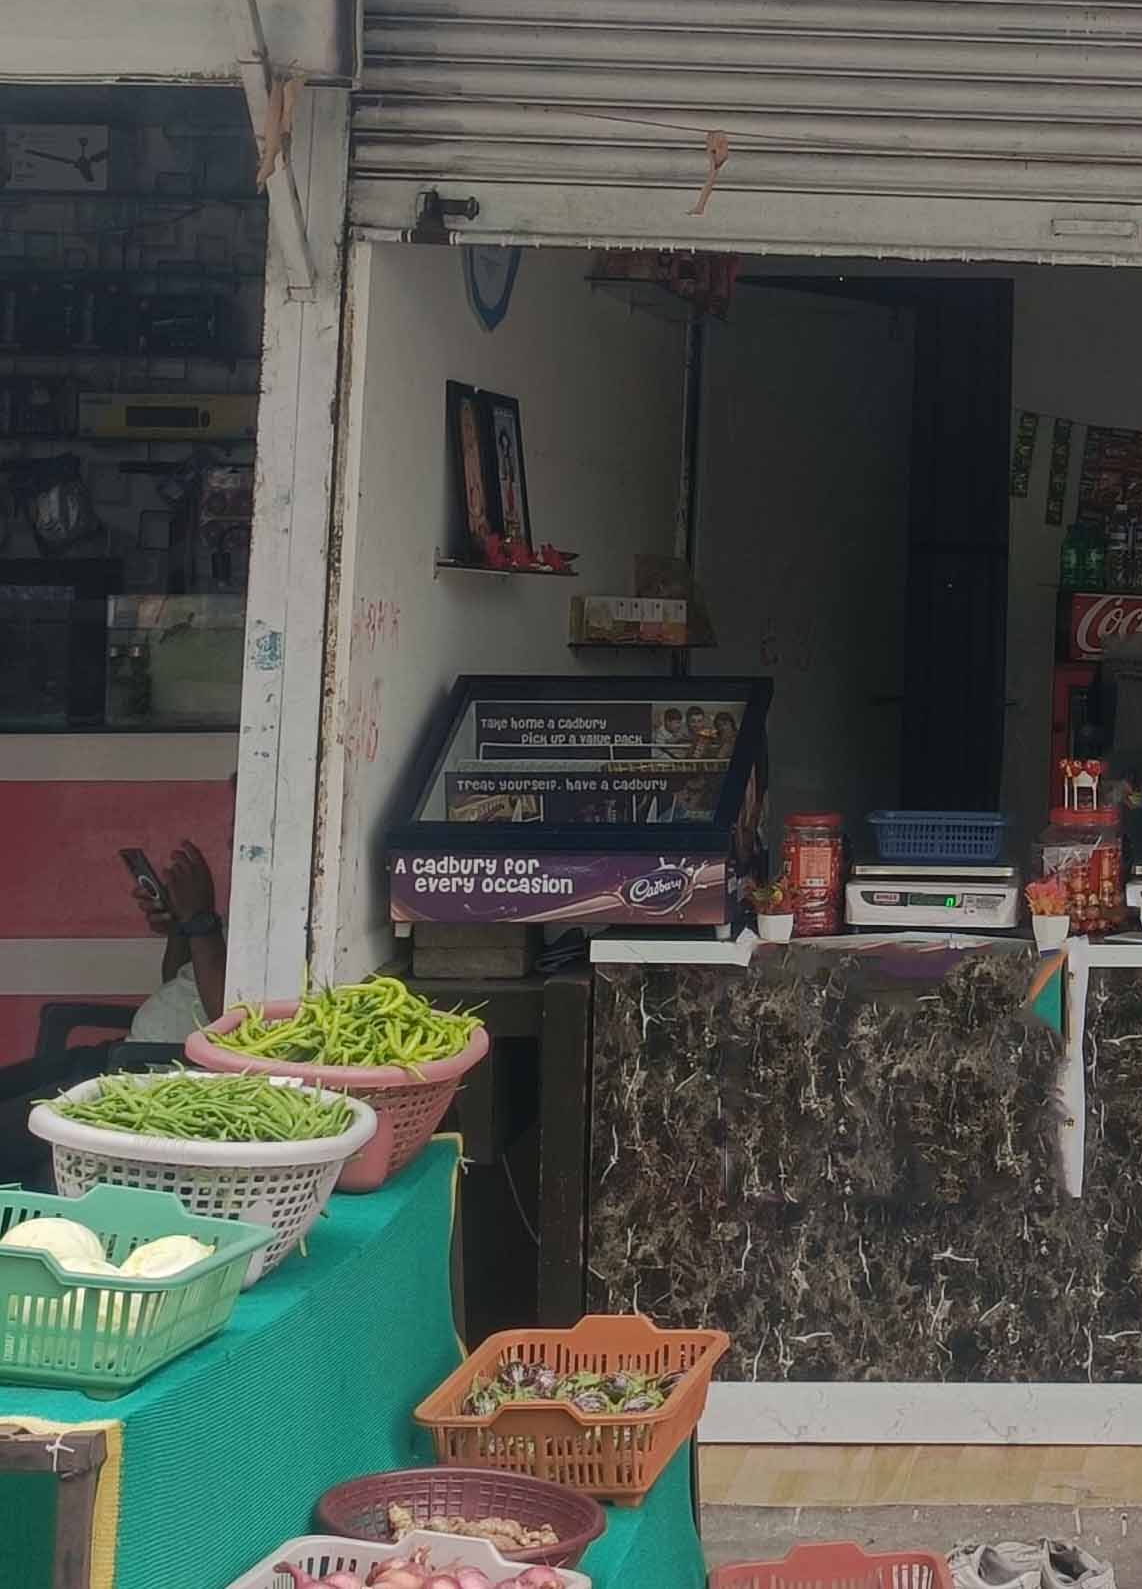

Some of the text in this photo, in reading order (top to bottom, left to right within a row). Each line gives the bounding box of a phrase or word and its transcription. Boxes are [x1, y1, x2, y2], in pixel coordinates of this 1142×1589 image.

[394, 857, 407, 875] A
[504, 857, 540, 875] for
[414, 874, 574, 895] every occasion
[629, 877, 682, 903] Cadbury
